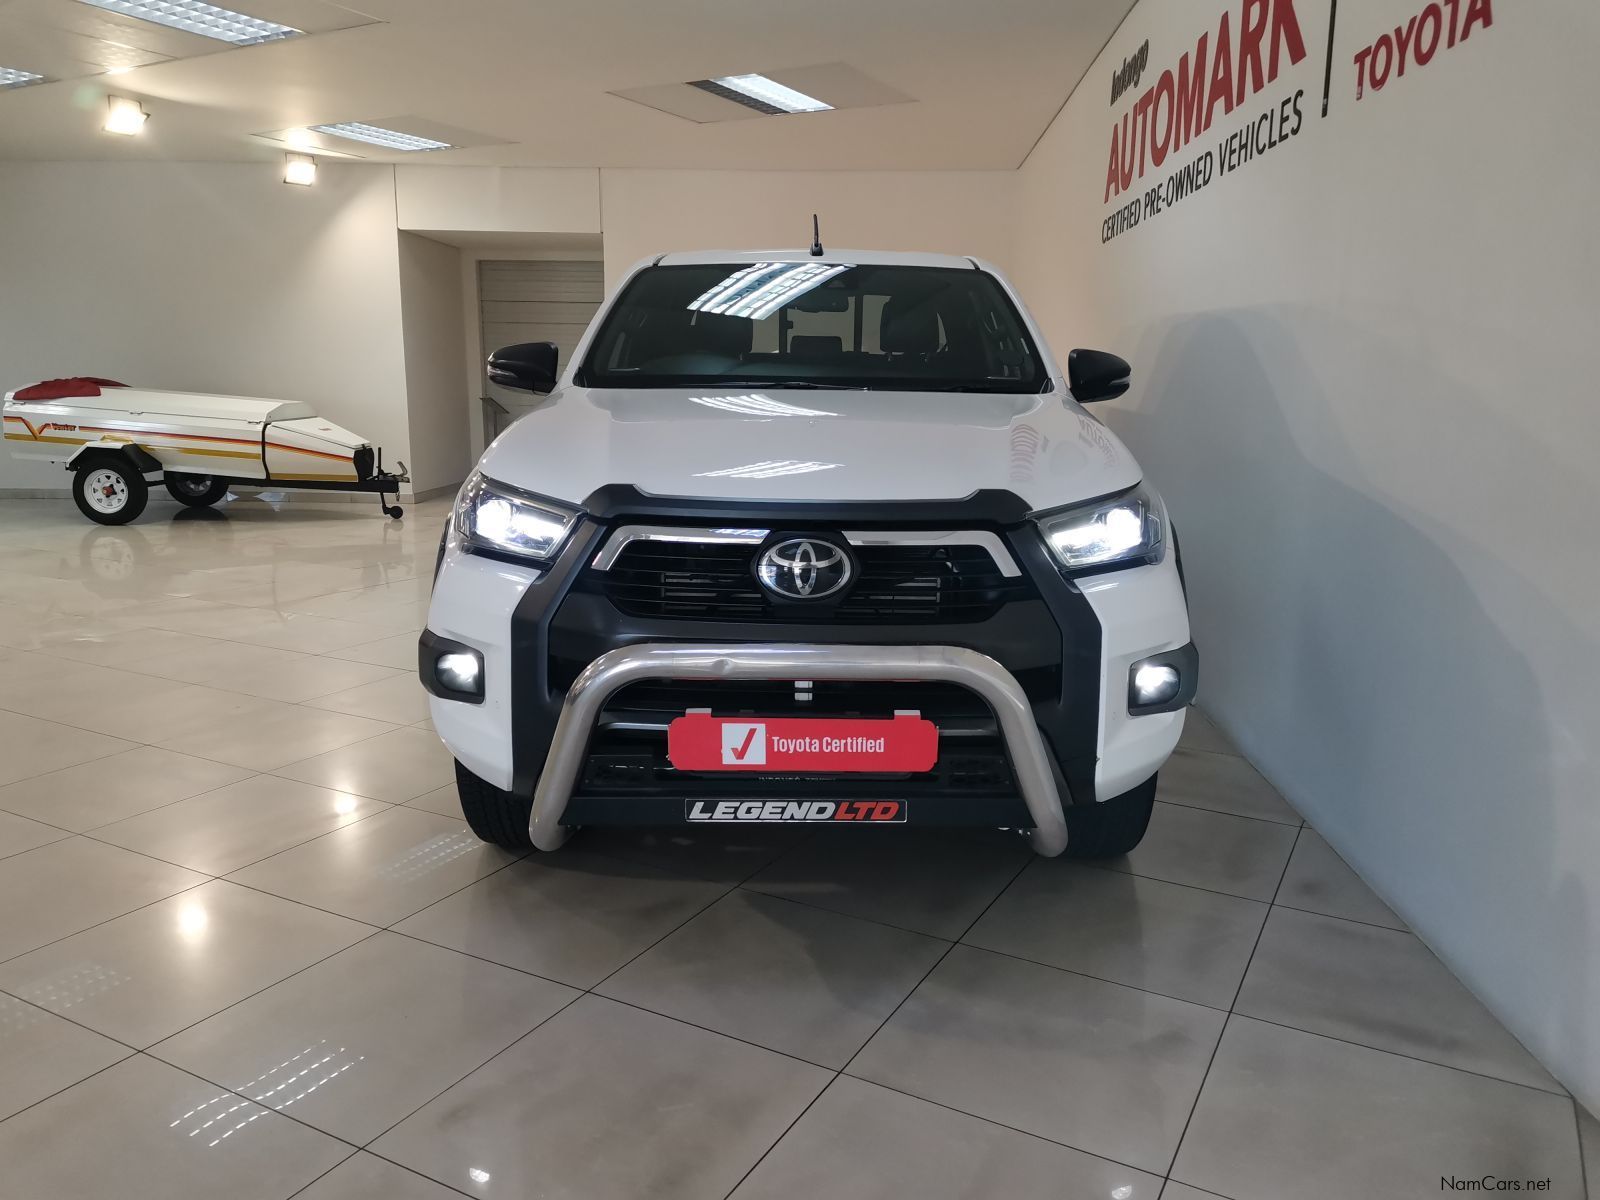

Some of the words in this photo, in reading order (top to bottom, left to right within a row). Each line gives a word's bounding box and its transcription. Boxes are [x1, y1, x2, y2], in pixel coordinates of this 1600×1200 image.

[1104, 0, 1307, 204] AUTOMARK
[1354, 0, 1493, 101] TOYOTA
[1101, 198, 1141, 245] CERTIFIED
[1144, 151, 1213, 221] PRE-OWNED
[1219, 89, 1304, 177] VEHICLES
[772, 736, 820, 754] Toyota
[822, 736, 885, 753] Certified
